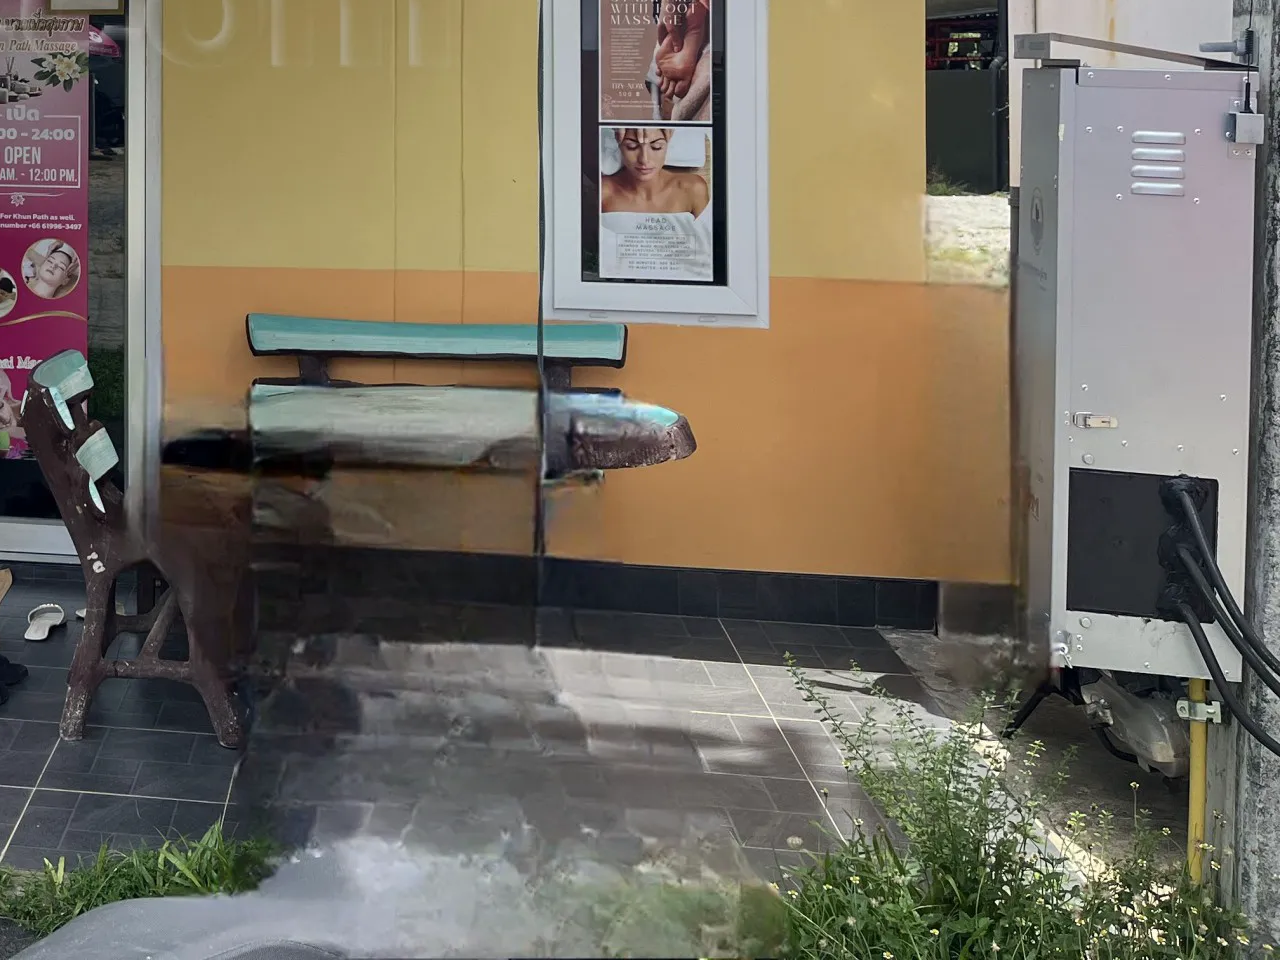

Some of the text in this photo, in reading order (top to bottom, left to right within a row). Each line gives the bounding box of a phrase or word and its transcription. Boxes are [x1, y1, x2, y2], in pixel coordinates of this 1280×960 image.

[611, 4, 697, 14] WITH FOOT
[611, 15, 682, 25] MASSAGE
[9, 40, 30, 50] Path
[34, 40, 76, 53] Massage
[6, 105, 39, 120] เปิด
[32, 129, 75, 140] 24:00
[4, 147, 41, 164] OPEN
[0, 169, 18, 180] AM.
[29, 169, 56, 181] 12:00
[59, 170, 77, 182] PM.
